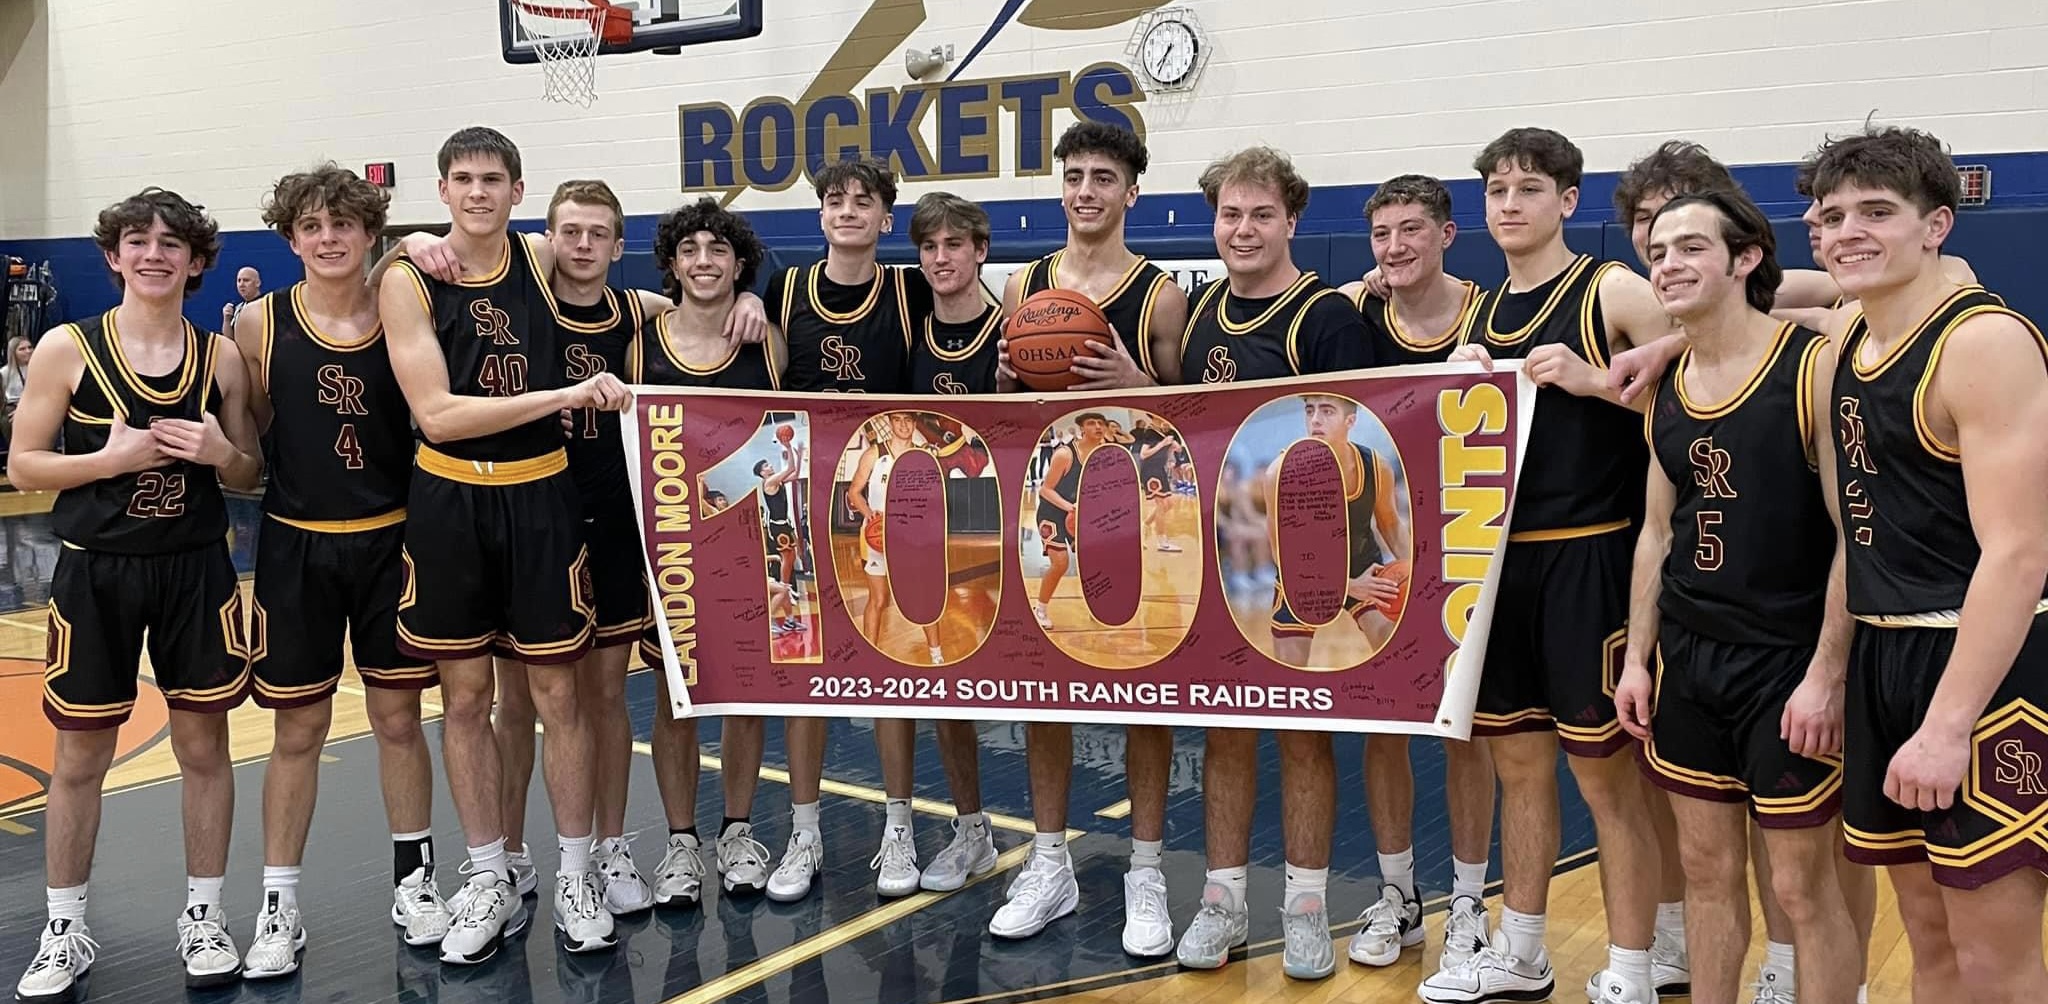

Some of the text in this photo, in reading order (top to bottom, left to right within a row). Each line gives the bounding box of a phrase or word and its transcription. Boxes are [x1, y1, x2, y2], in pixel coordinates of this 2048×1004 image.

[368, 165, 385, 184] EXIT
[469, 298, 520, 345] SR
[1017, 302, 1082, 328] Rawlings
[478, 354, 528, 398] 40
[820, 335, 865, 381] SR
[1018, 345, 1080, 361] OHSAA
[317, 364, 369, 415] SR
[334, 424, 364, 470] 4
[648, 403, 691, 533] MOORE
[1688, 436, 1738, 498] SR
[126, 471, 186, 519] 22
[695, 391, 1414, 673] 1000
[1694, 511, 1724, 571] 5
[808, 676, 948, 699] 2023-2024
[955, 679, 1058, 702] SOUTH
[1068, 682, 1180, 706] RANGE
[1189, 685, 1334, 711] RAIDERS
[1994, 738, 2048, 795] SR
